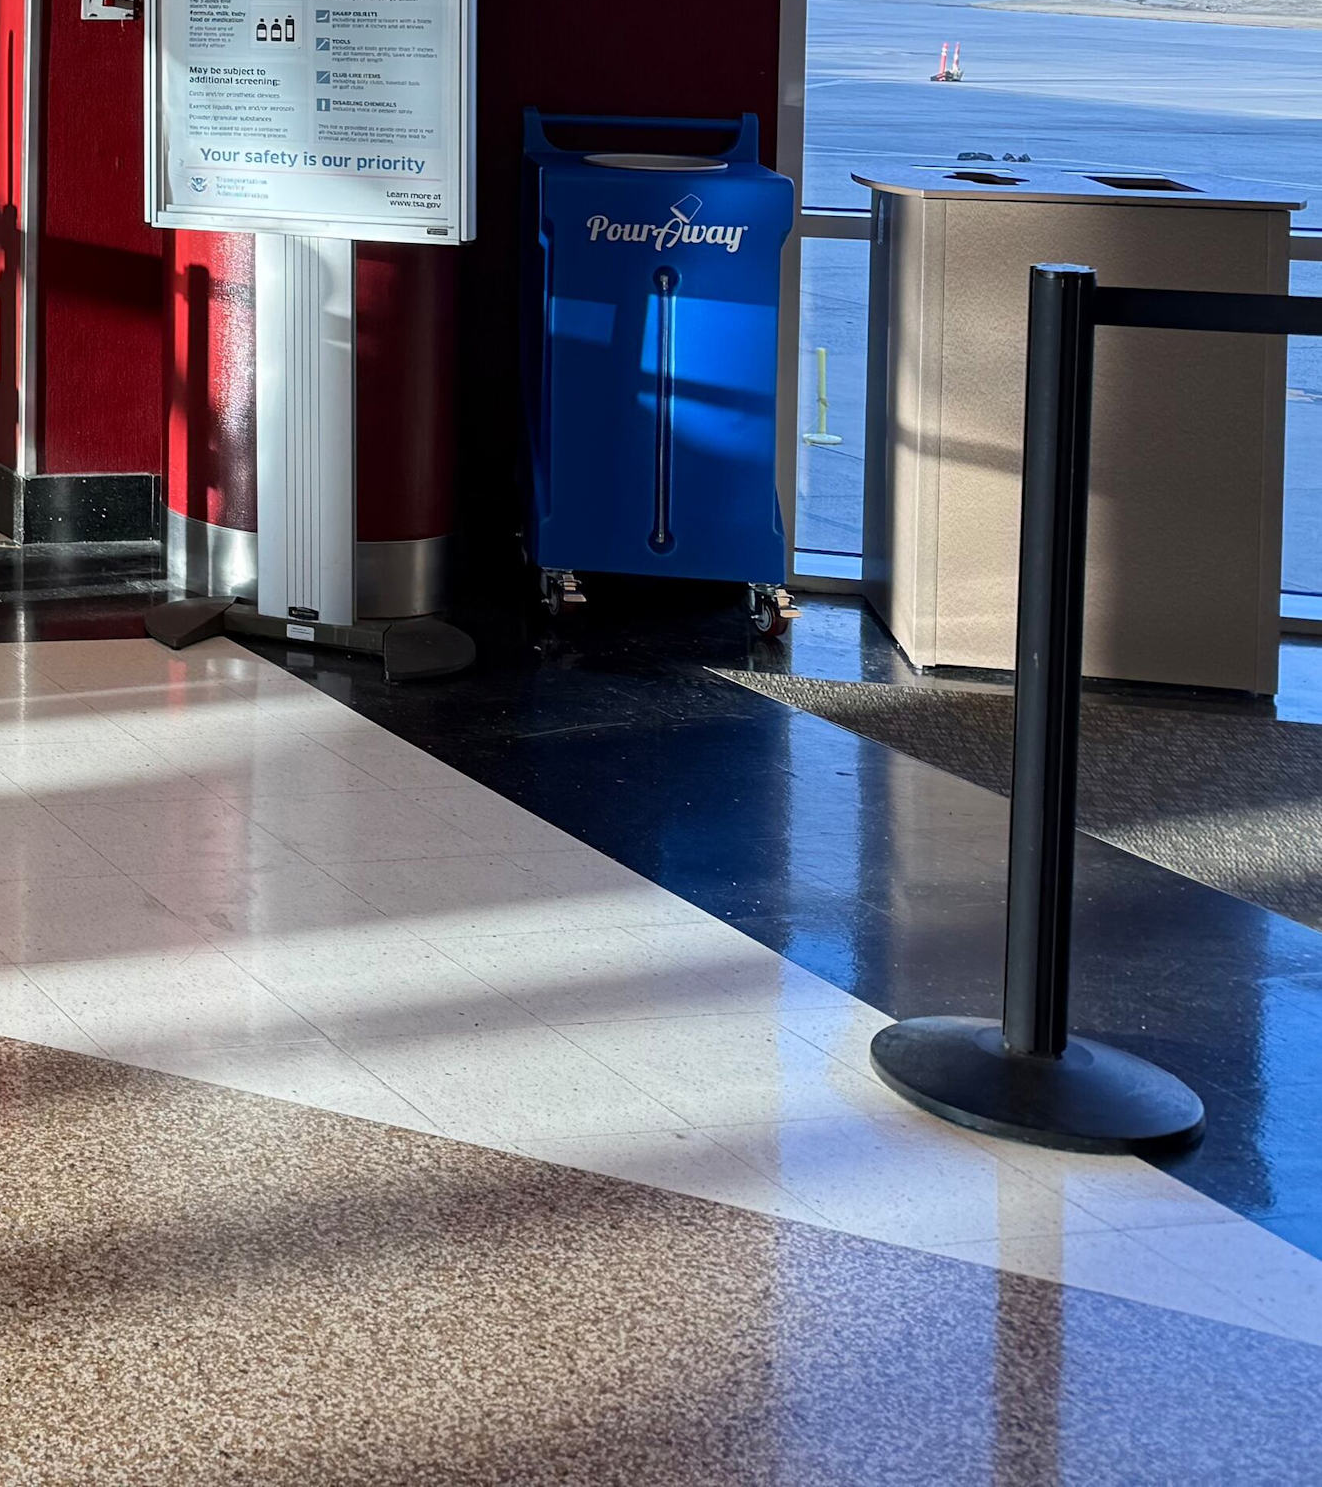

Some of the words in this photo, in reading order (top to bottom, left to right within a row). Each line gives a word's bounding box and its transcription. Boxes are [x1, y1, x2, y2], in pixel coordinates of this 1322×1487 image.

[189, 66, 208, 75] May
[210, 67, 221, 75] be
[223, 68, 254, 76] subject
[256, 68, 266, 76] to
[189, 76, 233, 84] additional
[200, 148, 240, 162] Your
[245, 149, 298, 168] safety
[304, 151, 317, 166] is
[322, 154, 351, 168] our
[356, 155, 425, 174] priority
[386, 190, 408, 199] Learn
[410, 191, 431, 200] more
[433, 192, 442, 200] at
[389, 200, 442, 210] www.tsa.gov
[586, 215, 744, 253] PourAway
